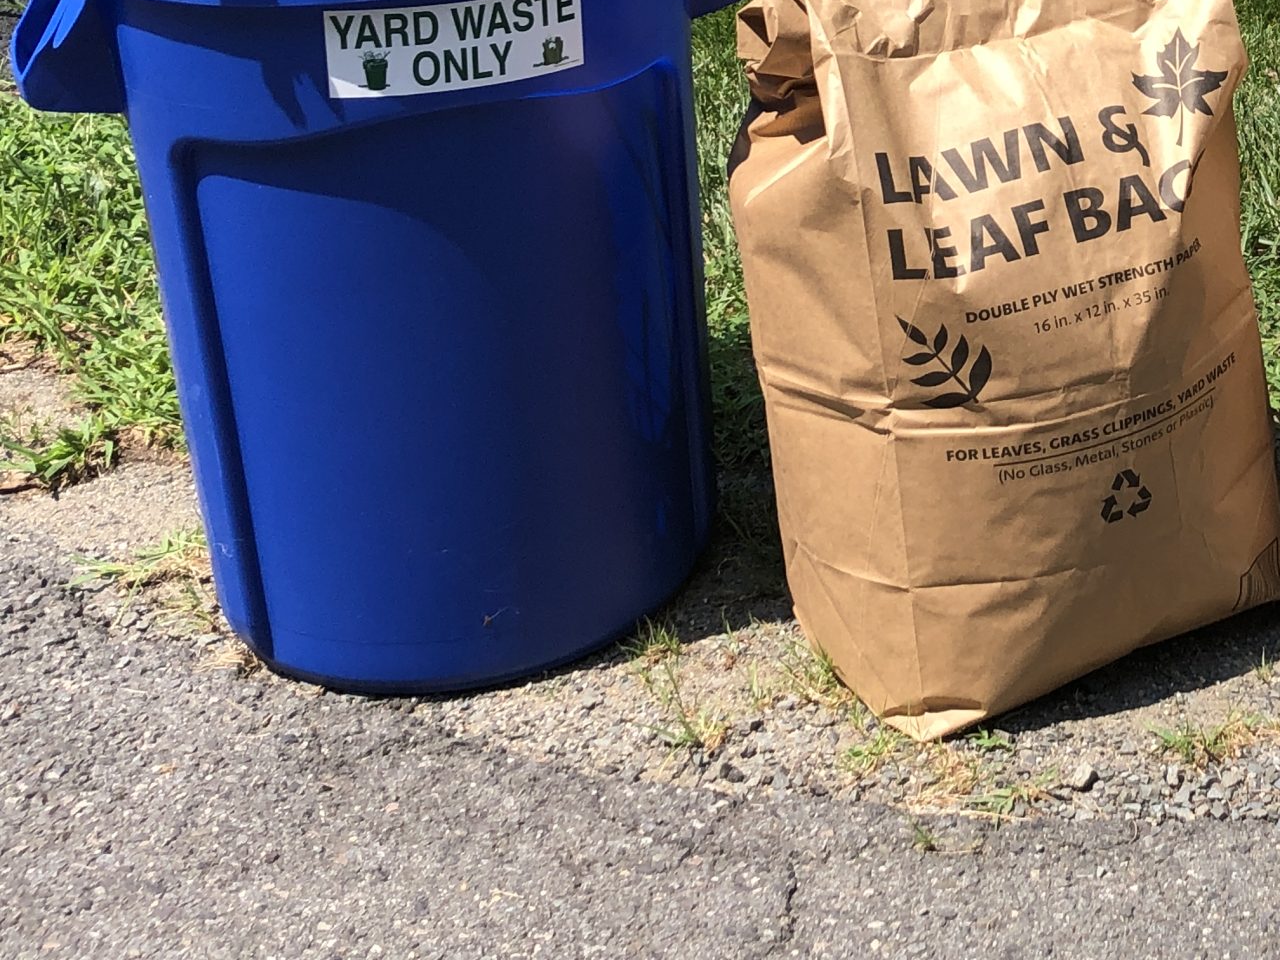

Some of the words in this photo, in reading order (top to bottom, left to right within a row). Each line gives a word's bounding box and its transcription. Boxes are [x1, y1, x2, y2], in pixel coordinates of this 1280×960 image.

[329, 10, 439, 50] YARD
[412, 41, 514, 87] ONLY
[874, 116, 1085, 204] LAWN
[1098, 105, 1151, 167] &
[887, 199, 1050, 281] LEAF
[965, 297, 1031, 324] DOUBLE
[1032, 290, 1059, 308] PLY
[1061, 279, 1095, 300] WET
[1098, 257, 1175, 290] STRENGTH
[1175, 237, 1203, 266] PAPER
[1033, 318, 1051, 334] 16
[1054, 314, 1073, 329] in.
[1074, 313, 1083, 324] x
[1085, 304, 1102, 320] 12
[1103, 300, 1120, 315] in.
[1123, 298, 1132, 309] x
[1135, 290, 1151, 306] 35
[1154, 285, 1170, 300] in.
[946, 448, 979, 463] FOR
[982, 441, 1047, 460] LEAVES,
[1049, 427, 1100, 450] GRASS
[1102, 400, 1176, 436] CLIPPINGS,
[1177, 378, 1205, 404] YARD
[1205, 351, 1236, 384] WASTE
[998, 469, 1026, 485] (No
[1029, 458, 1073, 478] Glass,
[1075, 446, 1120, 469] Metal,
[1122, 430, 1163, 453] Stones
[1166, 421, 1178, 435] or
